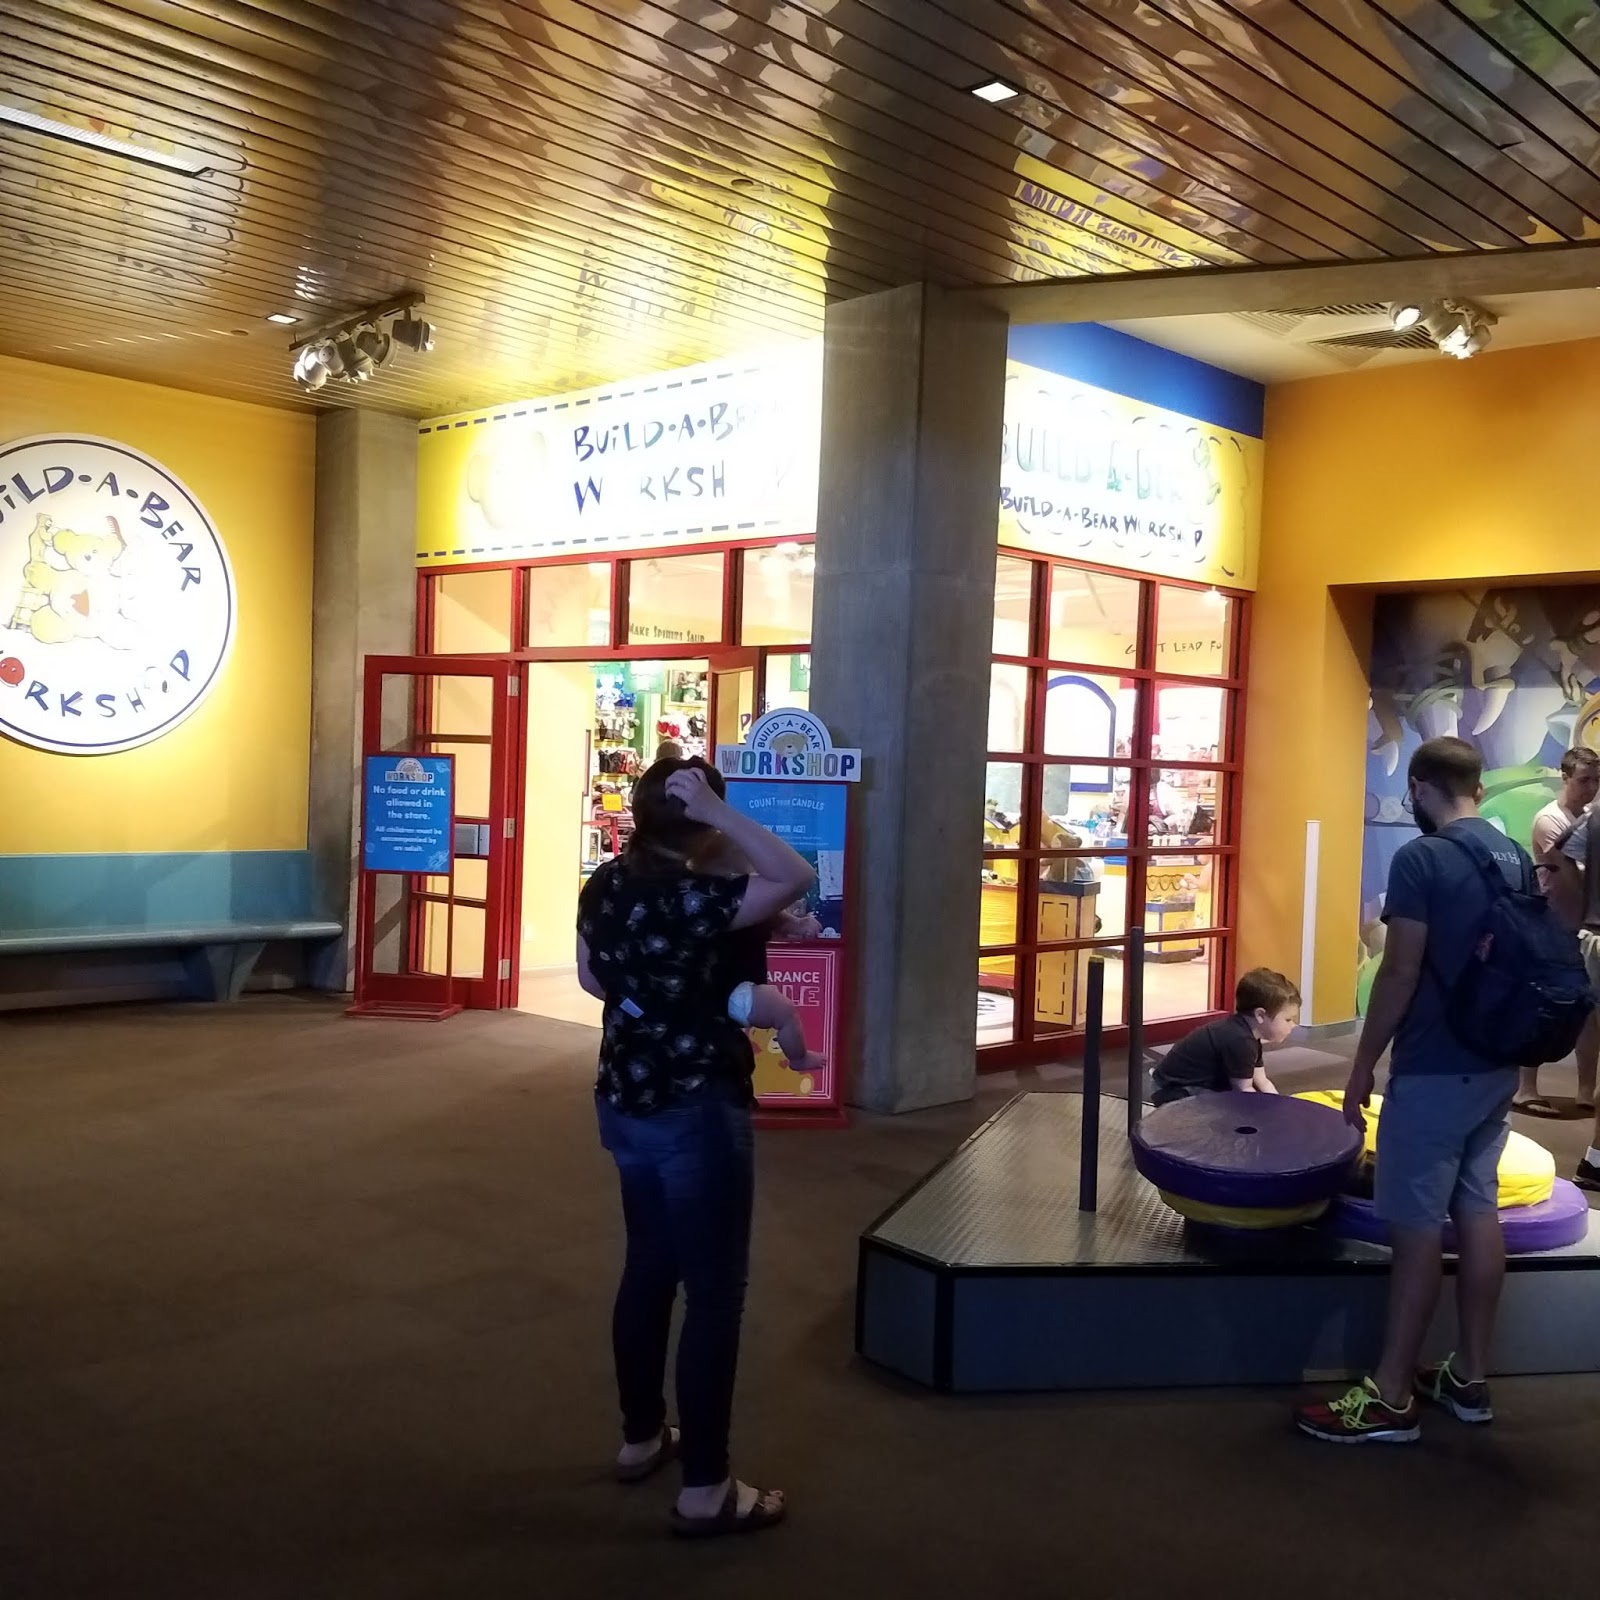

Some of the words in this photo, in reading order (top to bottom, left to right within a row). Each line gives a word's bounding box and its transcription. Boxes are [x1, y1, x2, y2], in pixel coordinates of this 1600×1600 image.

[757, 719, 820, 749] BUILD-A-BEAR
[721, 750, 855, 777] WORKSHOP
[373, 785, 386, 794] No
[387, 785, 408, 795] food
[421, 787, 446, 796] drink
[386, 797, 421, 808] allowed
[423, 799, 433, 808] in
[748, 797, 776, 809] COUNT
[791, 798, 825, 811] CANDLES
[387, 810, 403, 819] the
[404, 811, 431, 820] store.
[775, 824, 791, 833] YOUR
[767, 971, 820, 983] ARANCE
